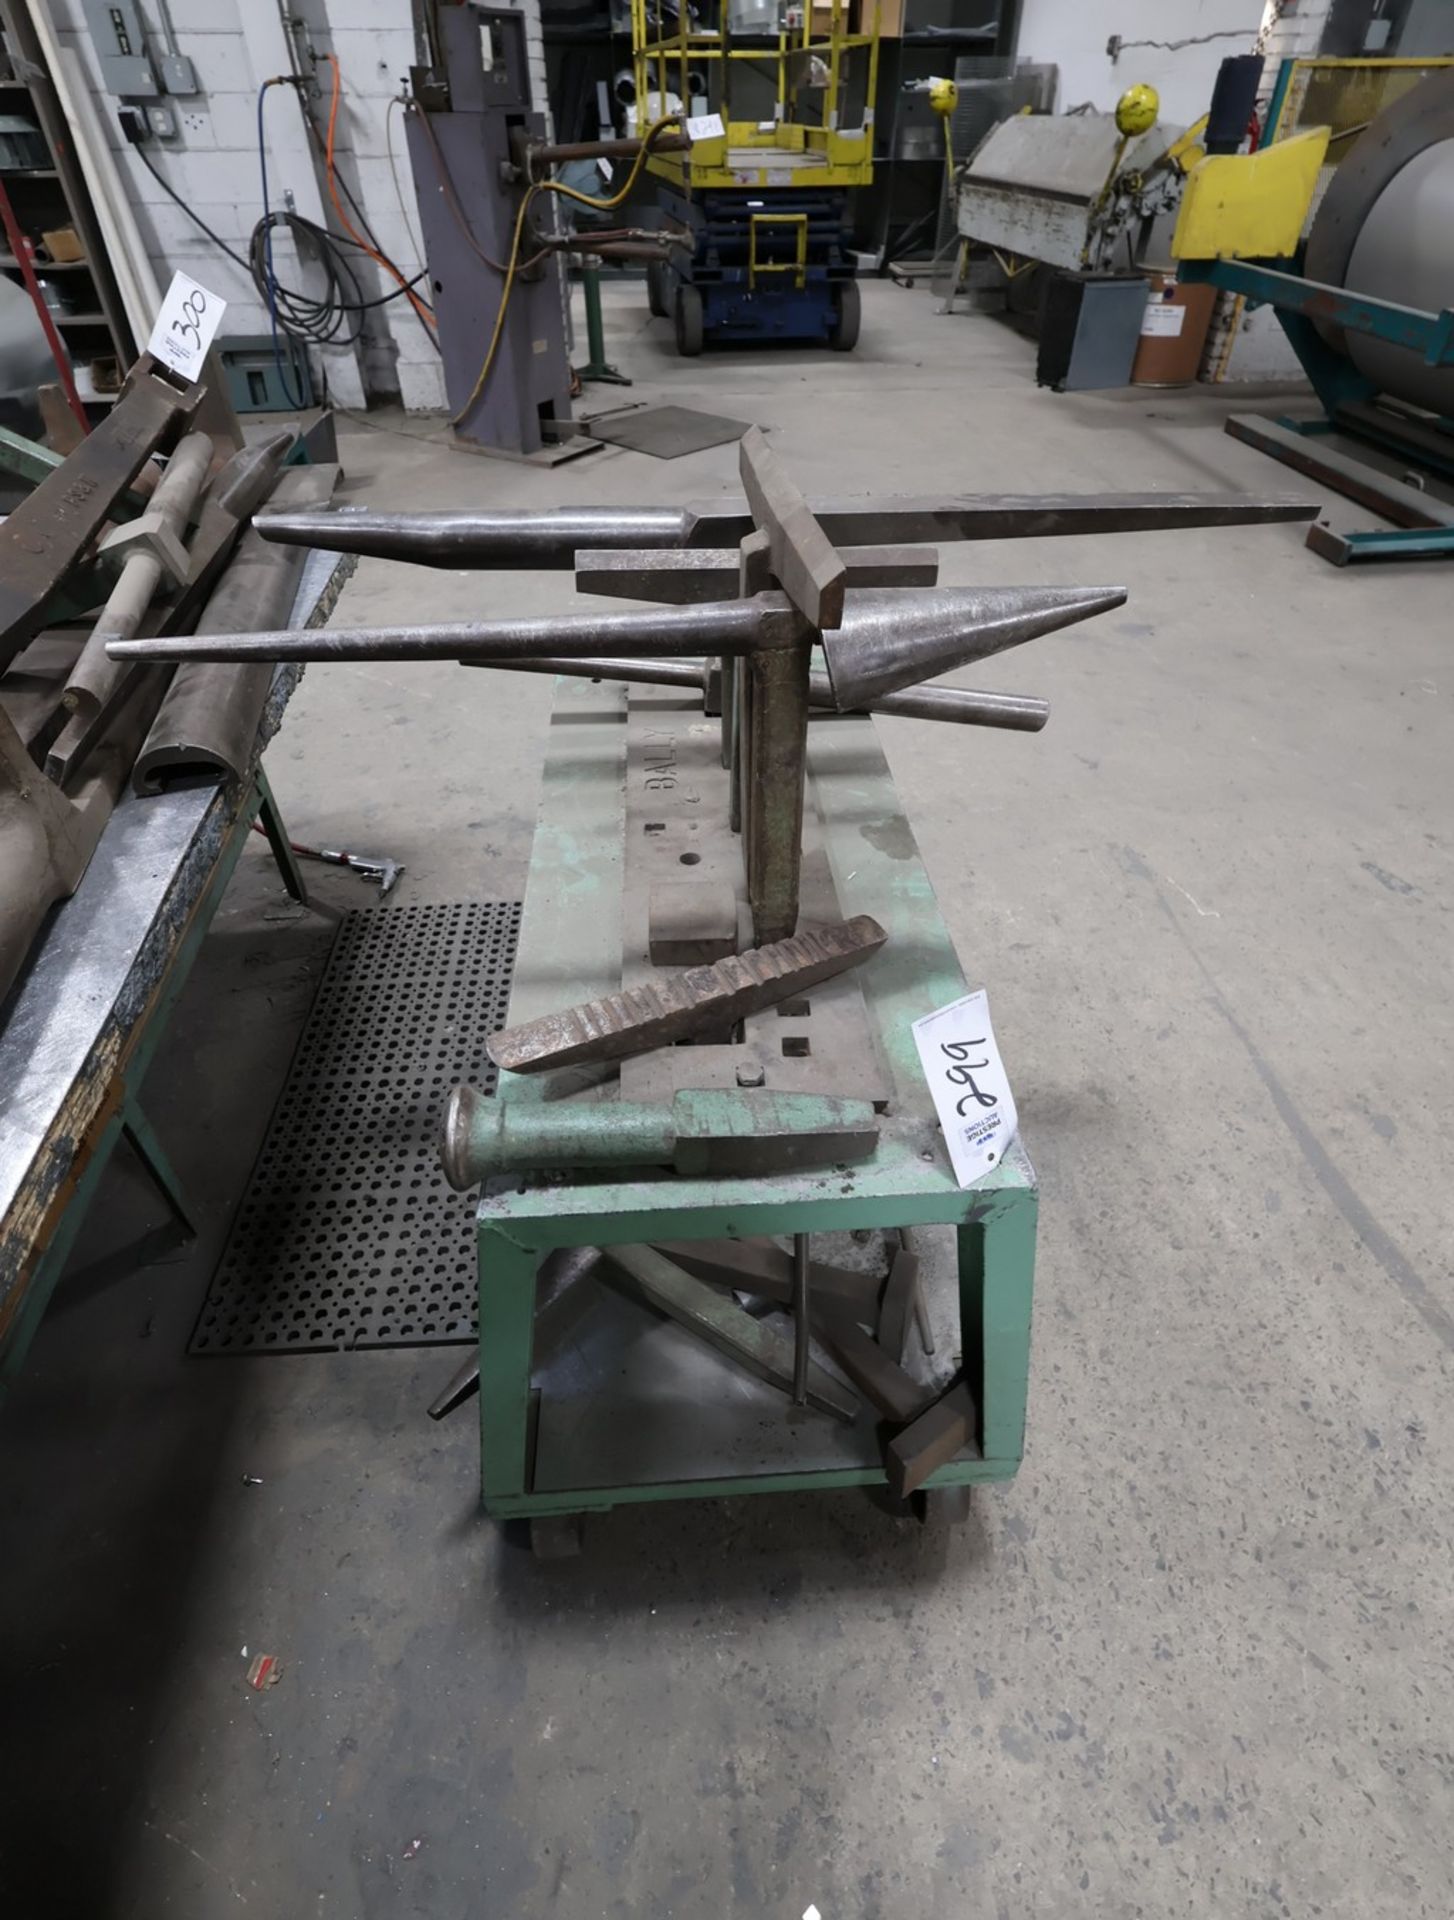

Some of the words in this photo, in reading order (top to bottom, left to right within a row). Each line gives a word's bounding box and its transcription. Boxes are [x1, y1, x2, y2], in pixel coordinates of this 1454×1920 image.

[172, 290, 206, 350] 300
[940, 1038, 998, 1117] 299
[967, 1118, 1002, 1142] PRESTIGE
